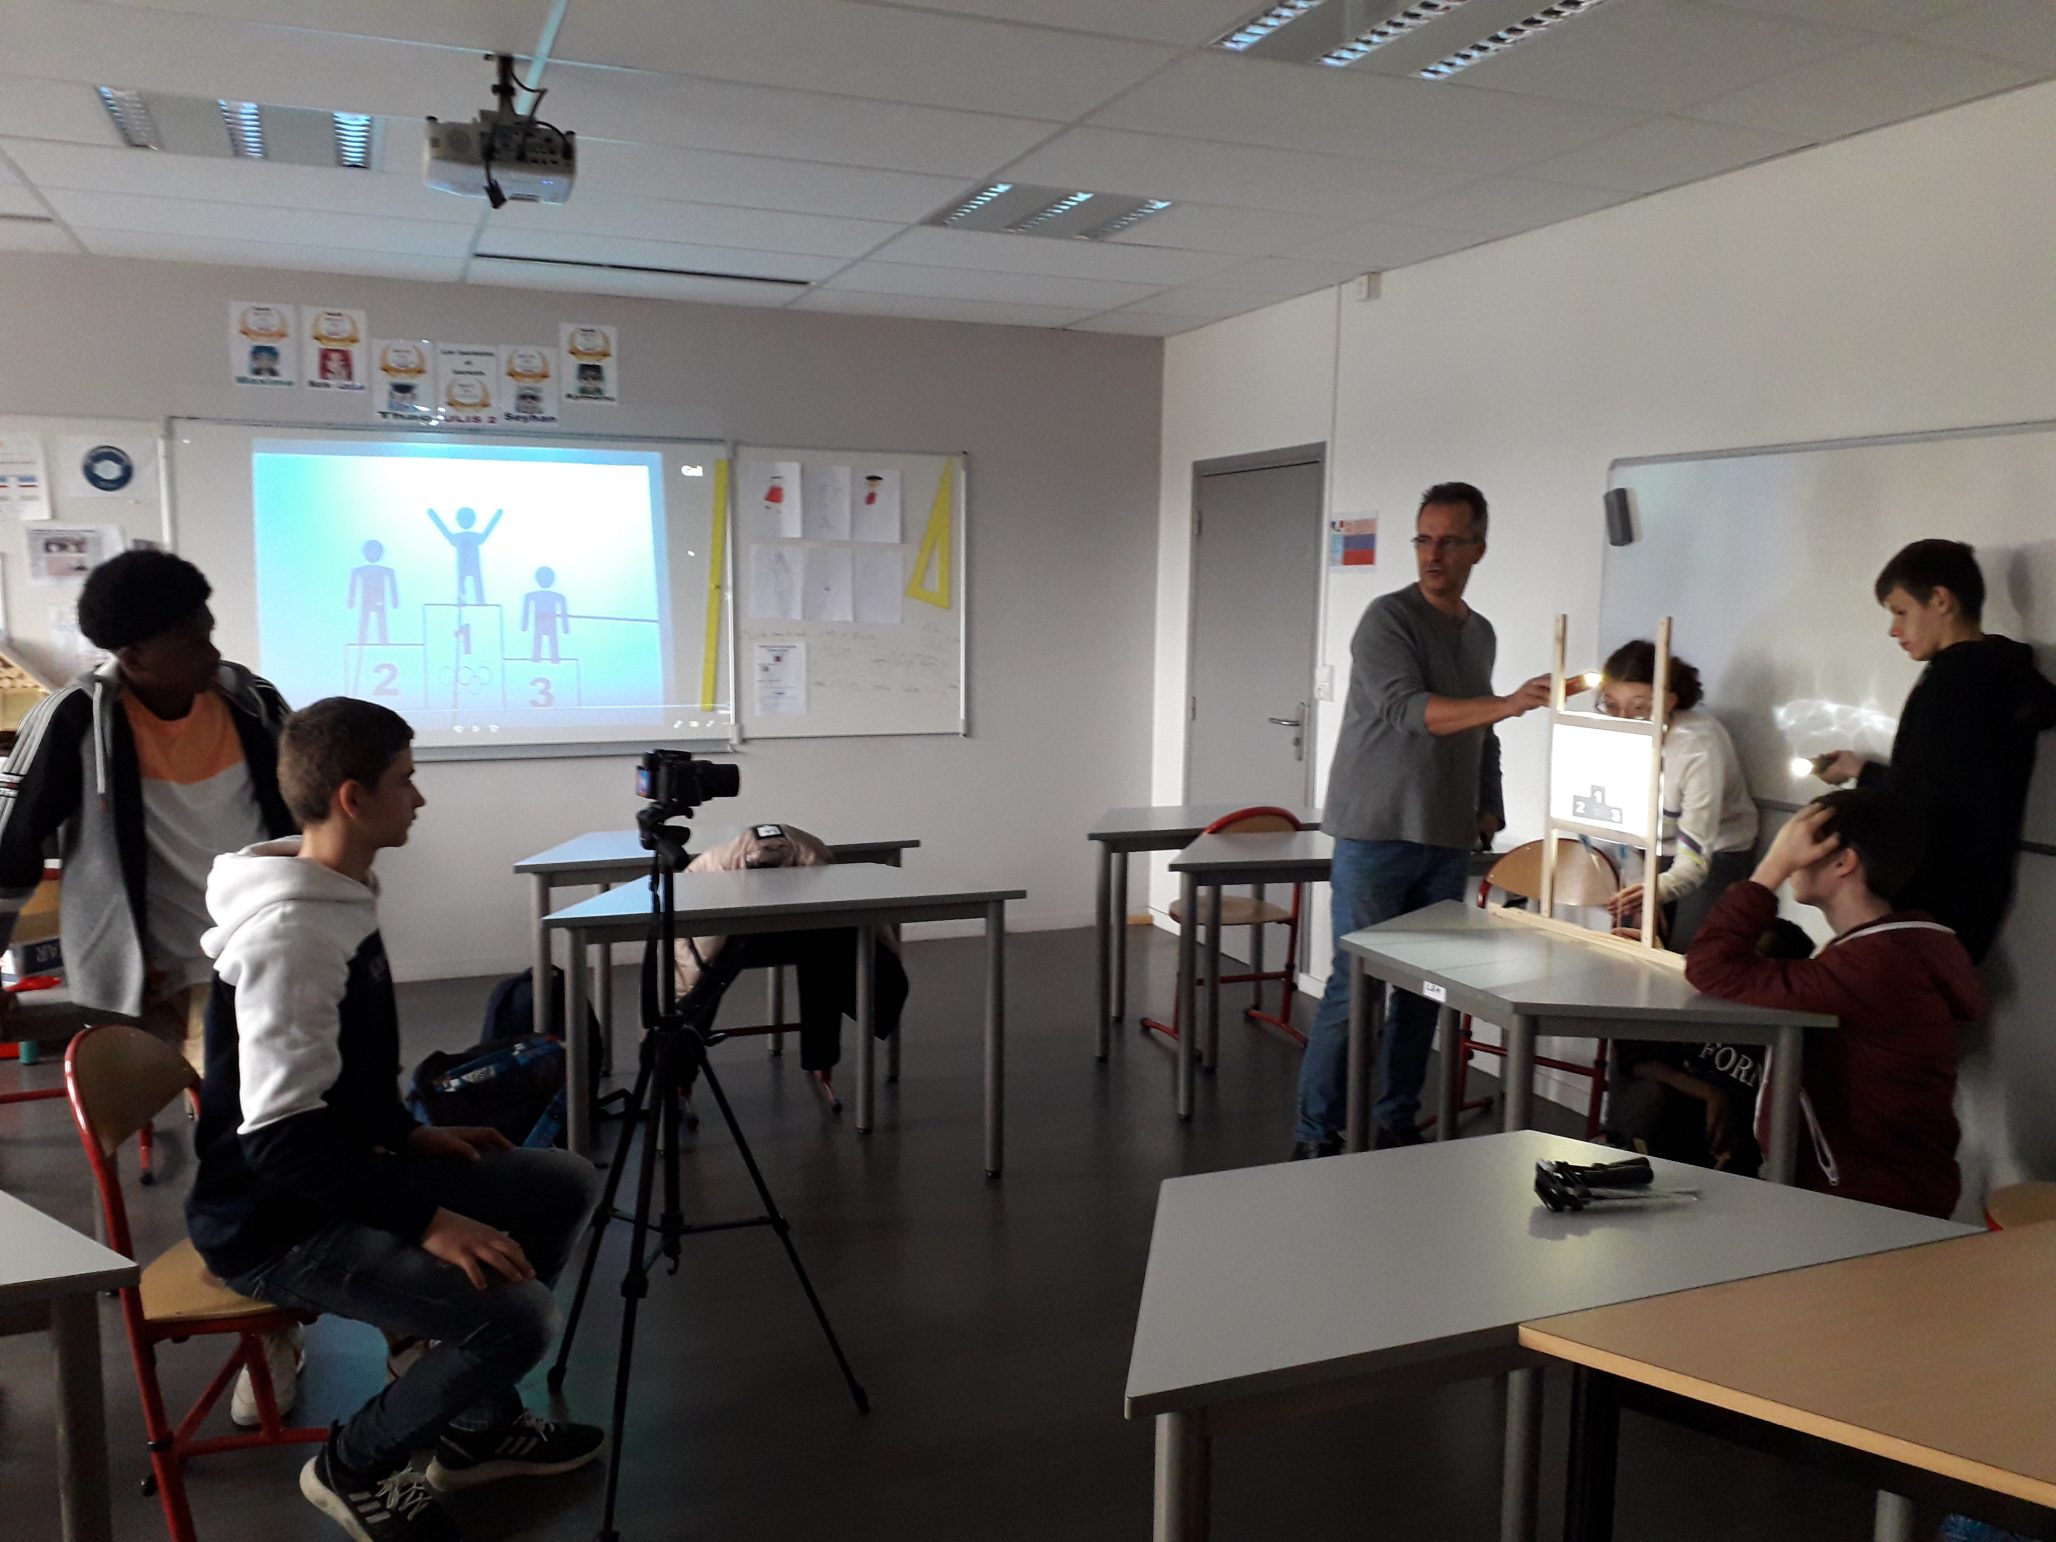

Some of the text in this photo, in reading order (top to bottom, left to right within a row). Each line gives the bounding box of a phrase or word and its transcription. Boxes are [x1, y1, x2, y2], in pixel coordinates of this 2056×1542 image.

[487, 416, 497, 424] 2
[454, 623, 471, 655] 1
[373, 663, 399, 697] 2
[529, 677, 555, 708] 3
[1575, 800, 1585, 813] 2
[1593, 790, 1603, 803] 1
